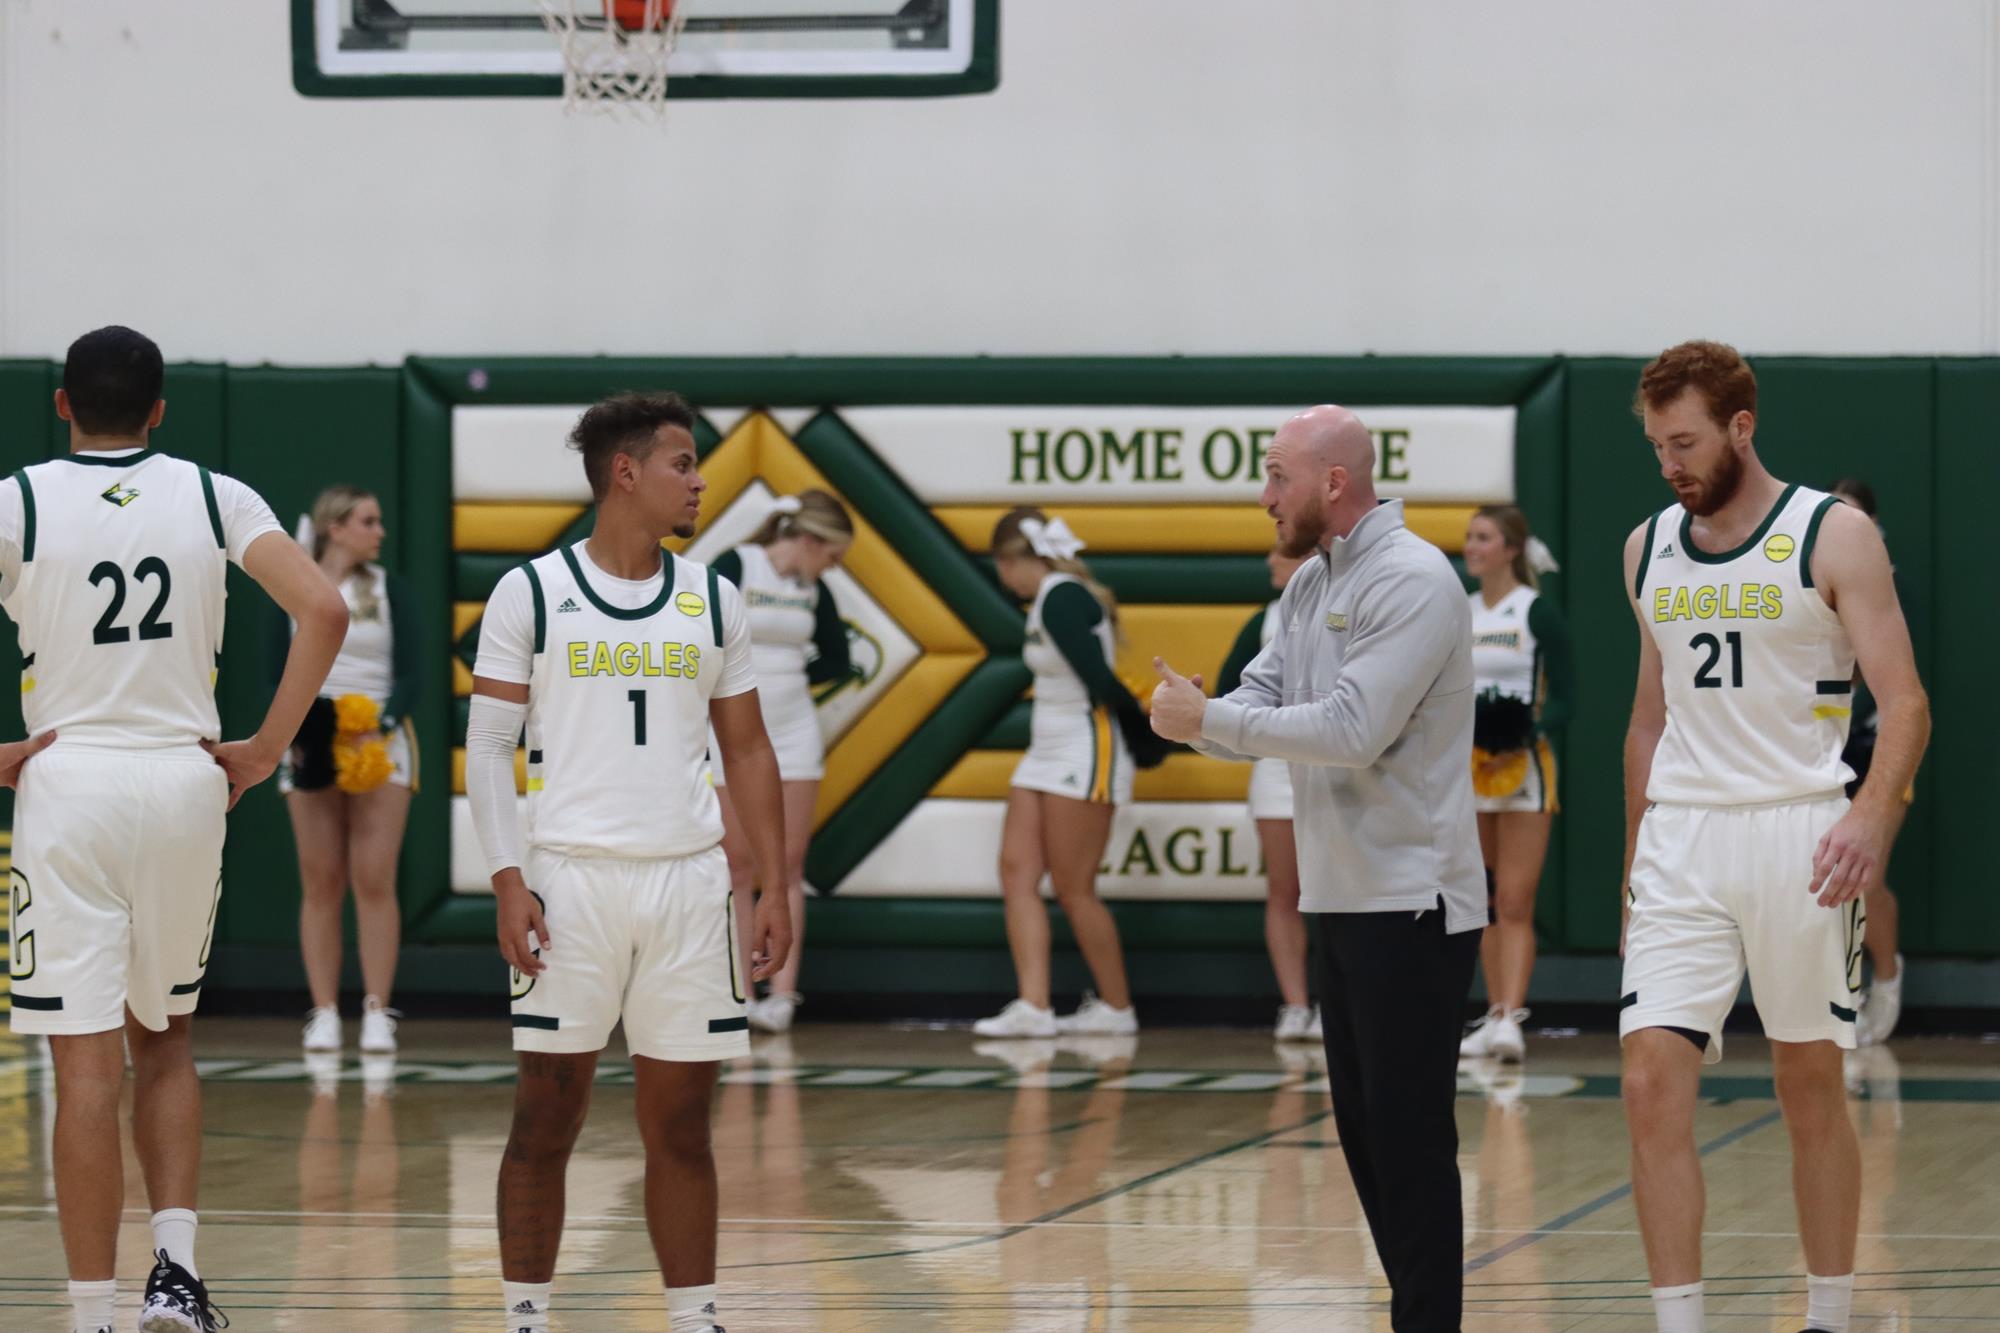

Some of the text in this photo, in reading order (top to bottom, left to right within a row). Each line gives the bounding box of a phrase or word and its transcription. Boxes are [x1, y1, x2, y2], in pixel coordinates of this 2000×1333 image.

[1009, 427, 1278, 483] HOME OF
[87, 555, 173, 645] 22
[1654, 583, 1783, 623] EAGLES
[567, 641, 701, 680] EAGLES
[1689, 631, 1743, 688] 21
[627, 689, 647, 745] 1
[1097, 826, 1268, 876] AGL
